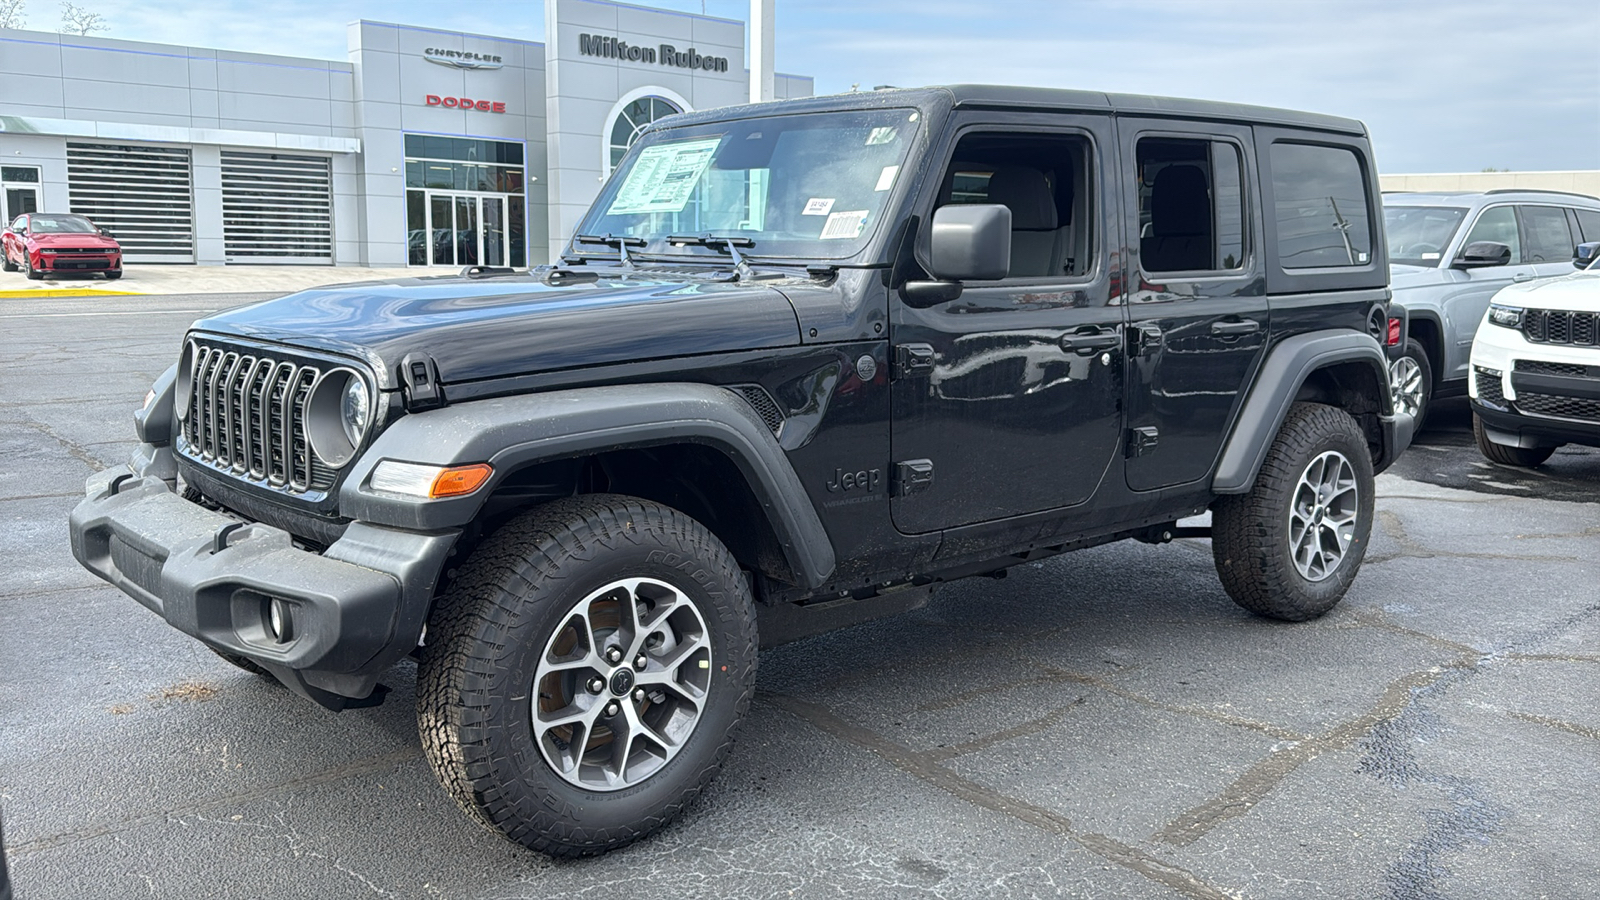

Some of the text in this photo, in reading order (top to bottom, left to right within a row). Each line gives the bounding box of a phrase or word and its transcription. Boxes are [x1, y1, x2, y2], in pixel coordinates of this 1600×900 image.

[425, 47, 502, 63] CHRYSLER
[579, 33, 728, 73] Milton Ruben
[426, 94, 506, 114] DODGE
[826, 467, 881, 493] Jeep
[822, 495, 874, 509] WRANGLER
[645, 549, 734, 623] ROADIAN
[507, 720, 583, 822] NEXEN
